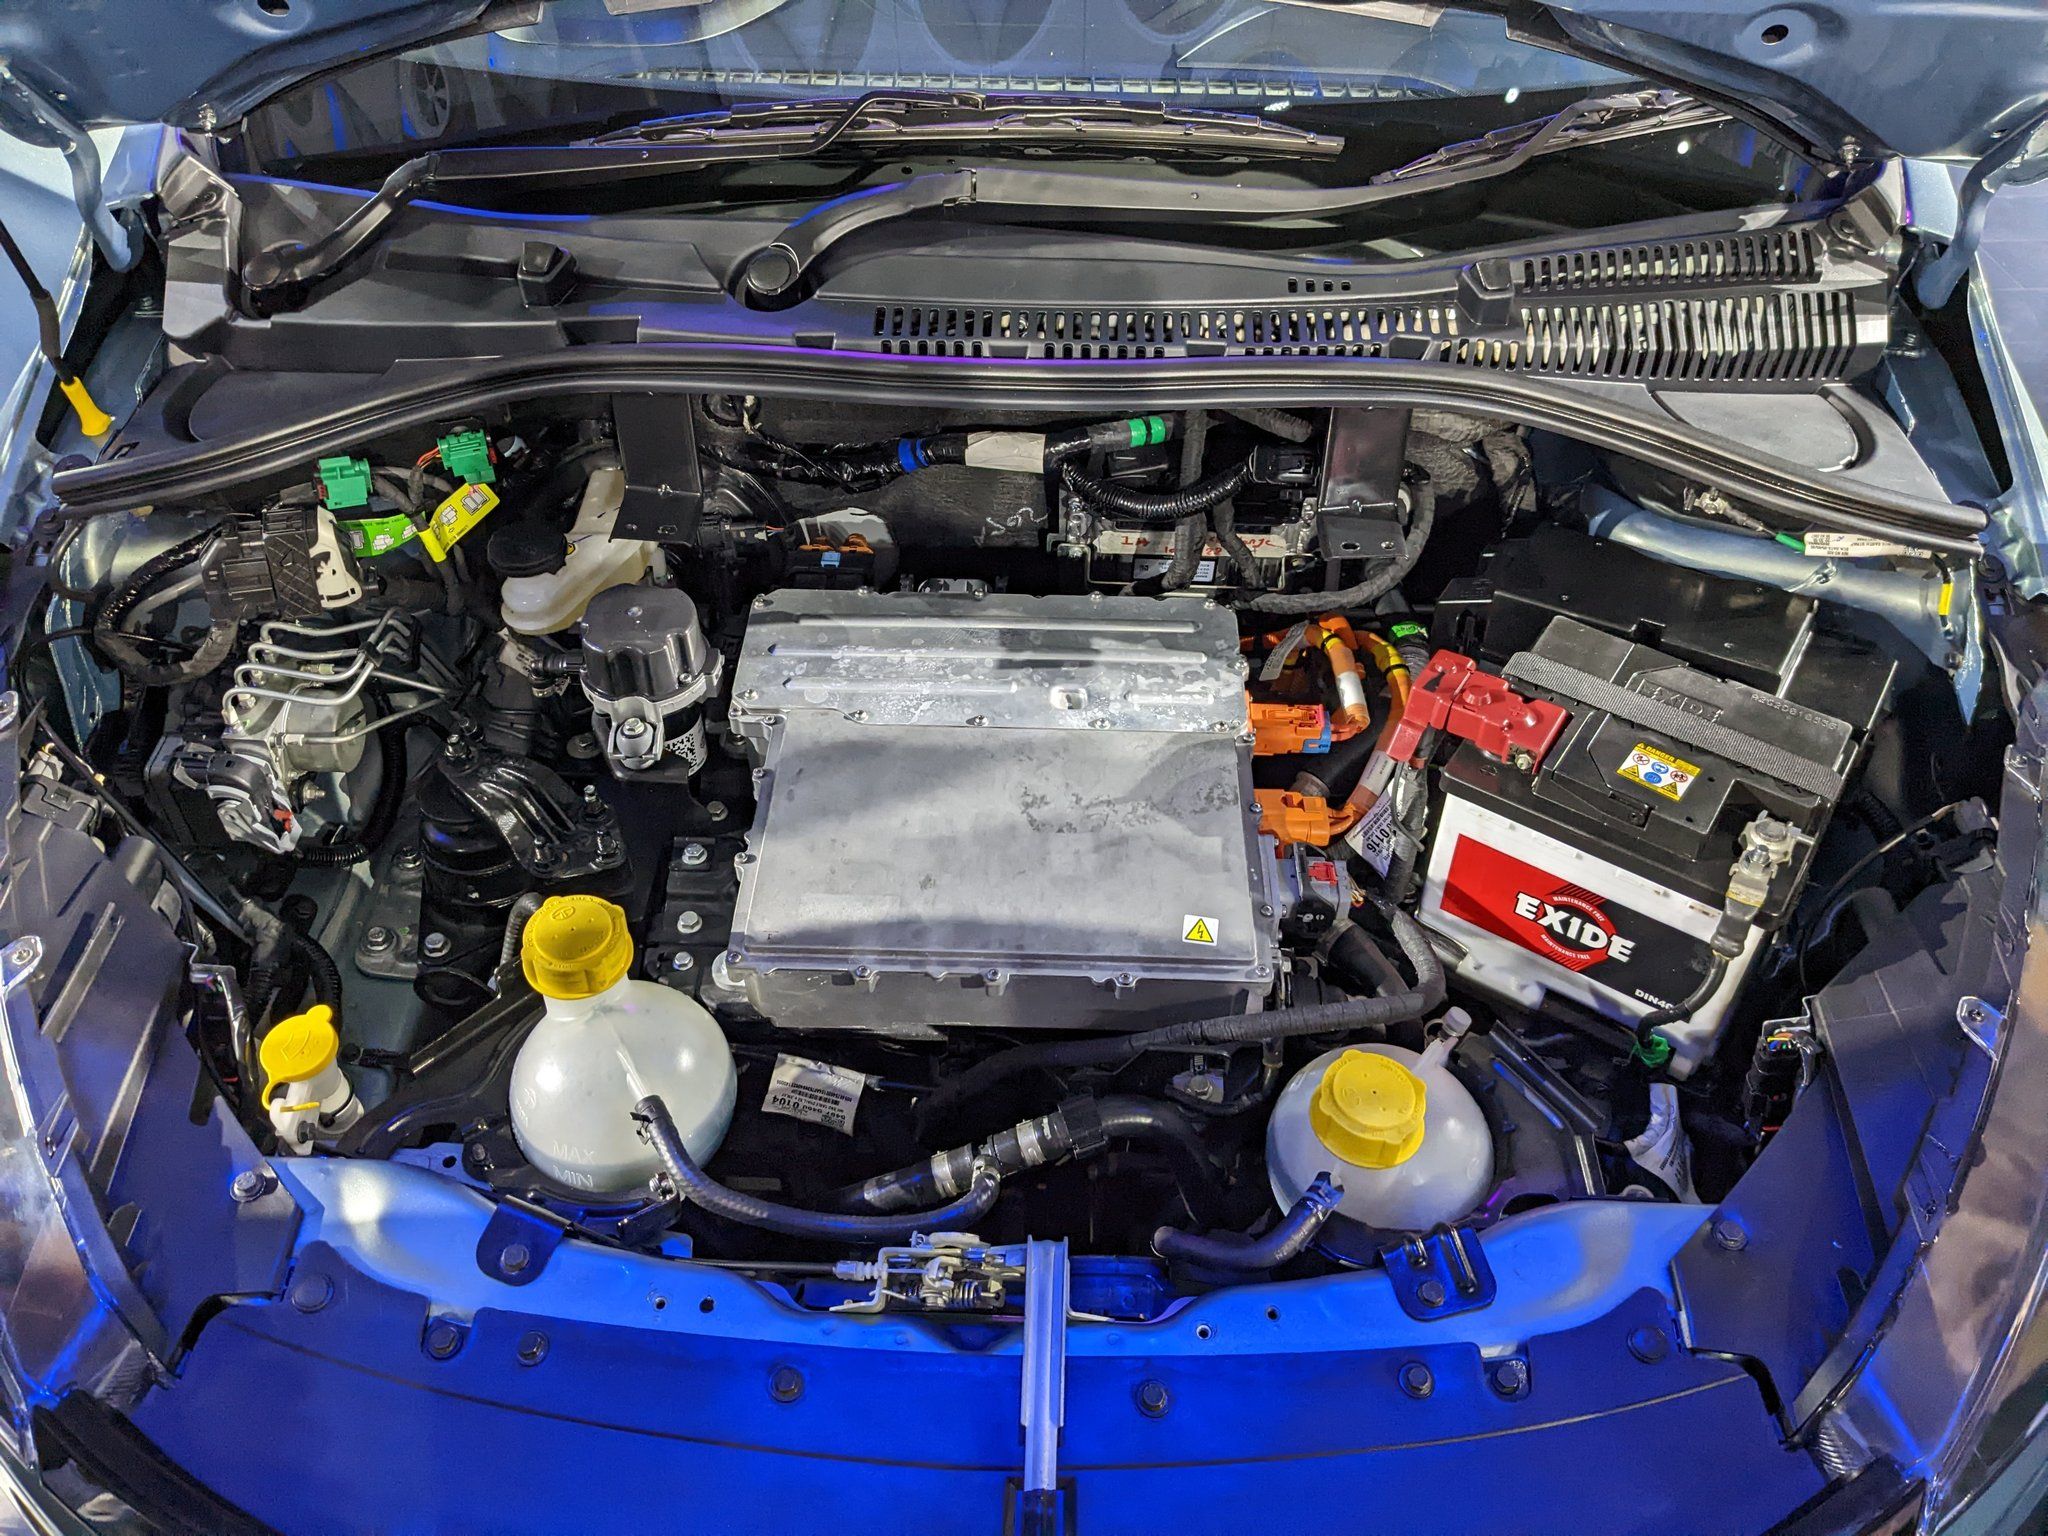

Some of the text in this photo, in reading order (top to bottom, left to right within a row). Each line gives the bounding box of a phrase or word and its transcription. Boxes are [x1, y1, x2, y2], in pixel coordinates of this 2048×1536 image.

[1645, 746, 1675, 762] DANGER
[1366, 828, 1390, 853] 0116
[1553, 896, 1605, 922] MAINTENANCE FREE
[1516, 892, 1635, 962] EXIDE
[1540, 934, 1576, 958] MAINTENANCE
[771, 1095, 800, 1109] 0104
[552, 1140, 594, 1164] MAX
[552, 1165, 594, 1187] MIN
